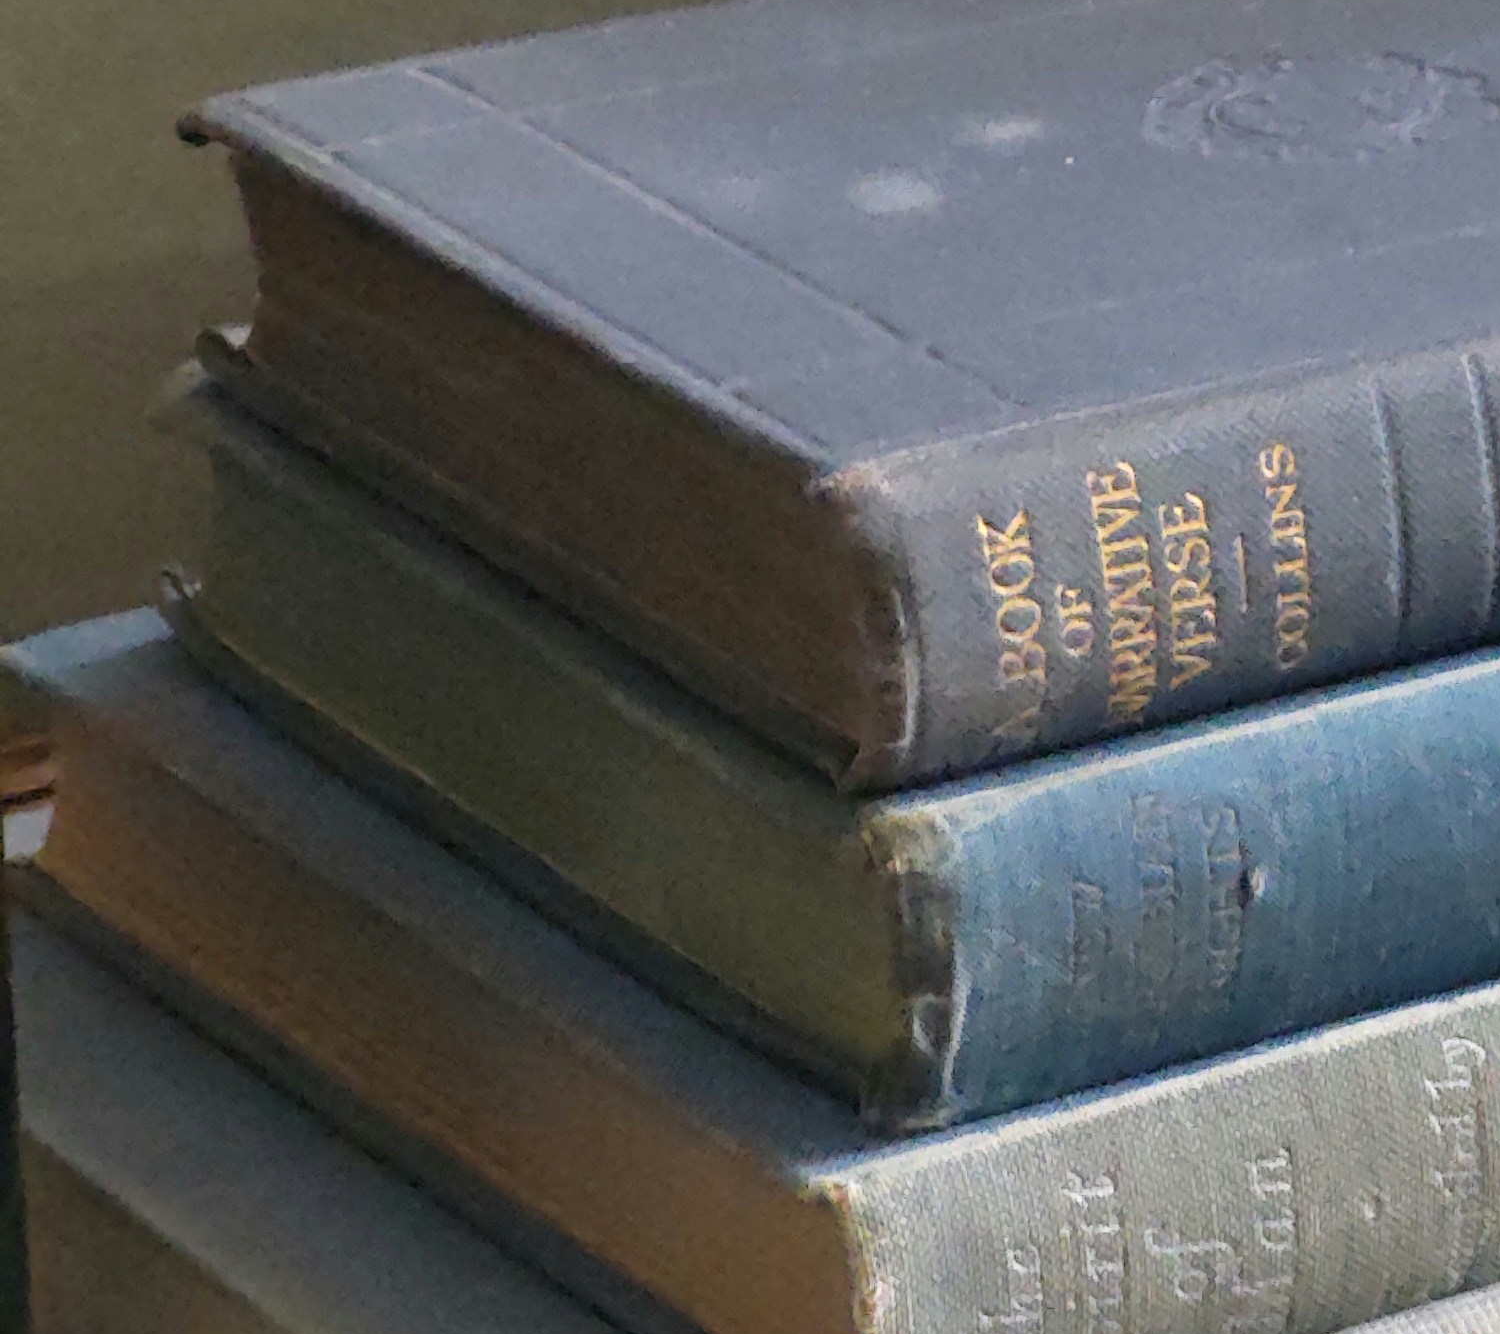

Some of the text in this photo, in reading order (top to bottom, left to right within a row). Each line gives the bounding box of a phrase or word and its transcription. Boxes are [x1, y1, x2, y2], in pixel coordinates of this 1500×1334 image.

[975, 507, 1048, 687] BOOK
[1054, 581, 1096, 658] OF
[1085, 460, 1158, 727] NARRATIVE
[1157, 490, 1218, 691] VERSE
[1259, 442, 1312, 671] COLLINS
